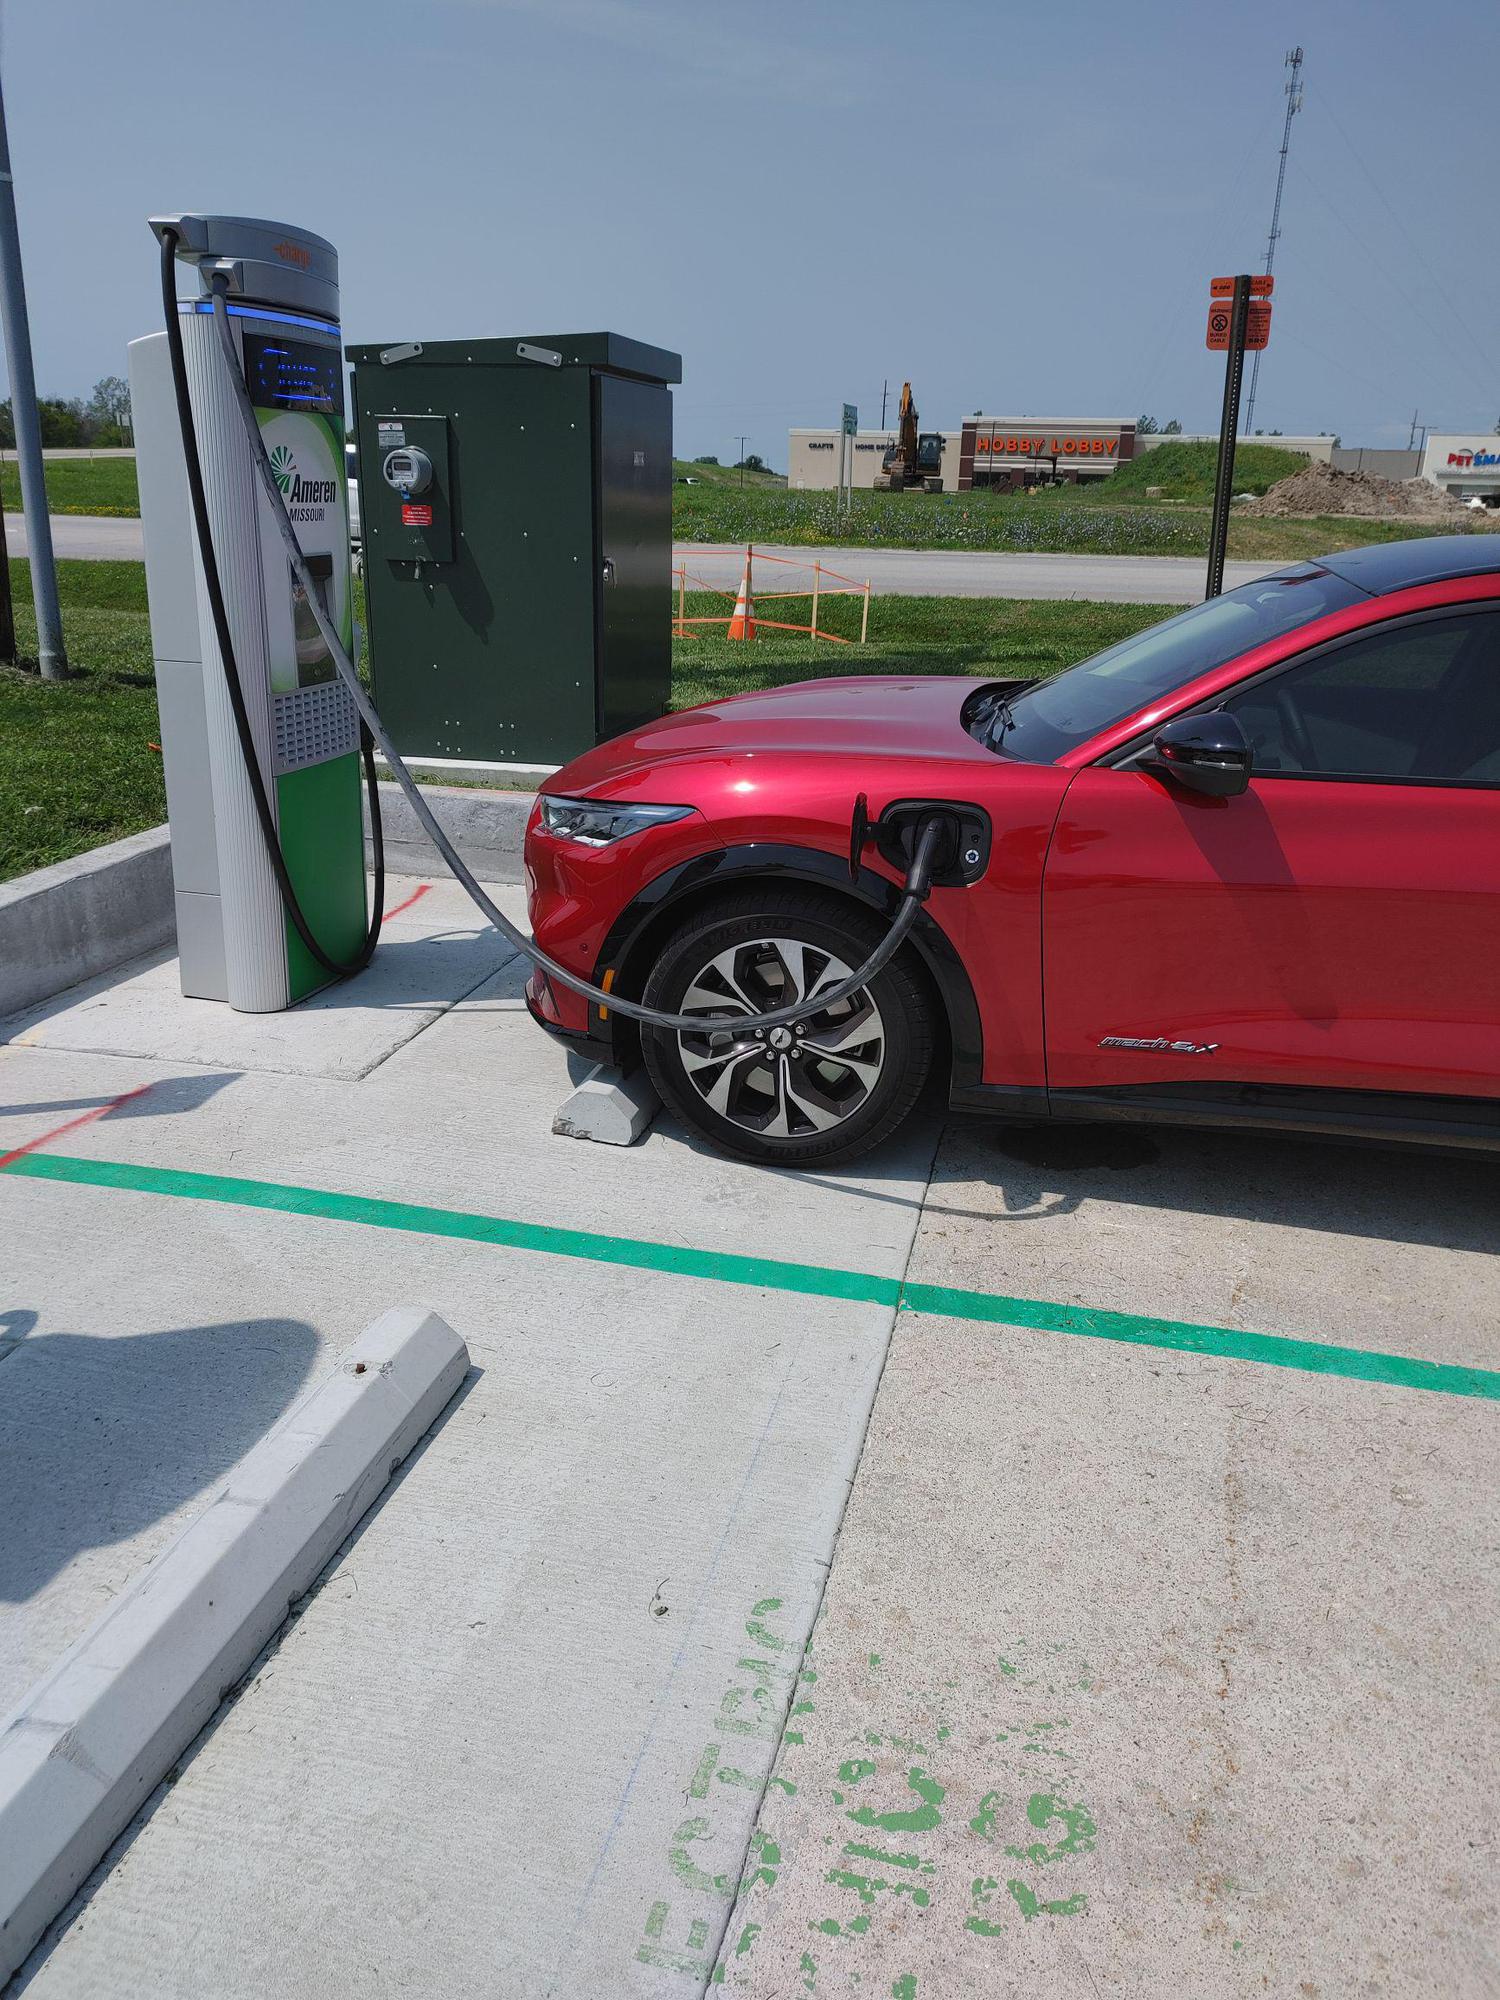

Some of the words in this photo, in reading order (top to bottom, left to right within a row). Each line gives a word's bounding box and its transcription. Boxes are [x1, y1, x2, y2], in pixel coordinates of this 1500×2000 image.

[977, 437, 1045, 453] HOBBY
[1051, 438, 1118, 453] LOBBY
[290, 474, 336, 503] Ameren
[290, 508, 325, 521] MISSOURI
